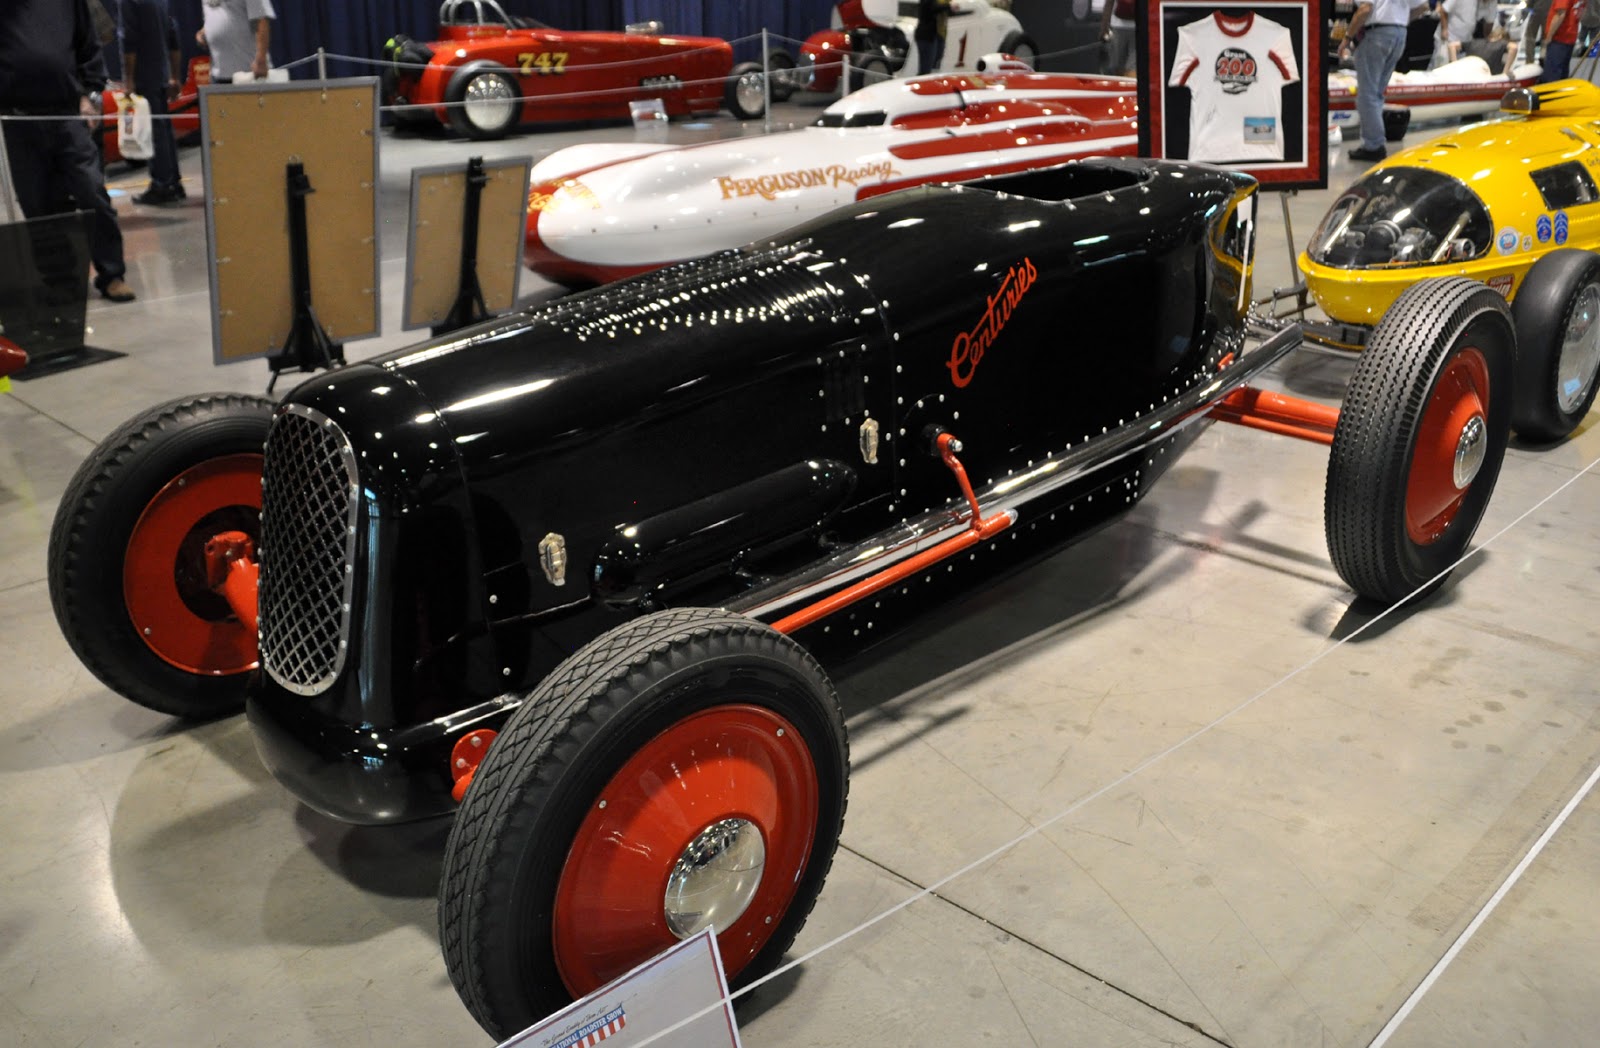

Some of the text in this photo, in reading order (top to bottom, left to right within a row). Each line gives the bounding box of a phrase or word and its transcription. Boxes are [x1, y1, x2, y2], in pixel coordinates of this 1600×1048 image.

[518, 52, 568, 75] 747
[1217, 57, 1256, 76] 200
[715, 161, 902, 200] FERGUSON Racing
[946, 257, 1037, 388] Centuries
[579, 1017, 607, 1037] ROADSTER
[606, 1007, 623, 1021] SHOW
